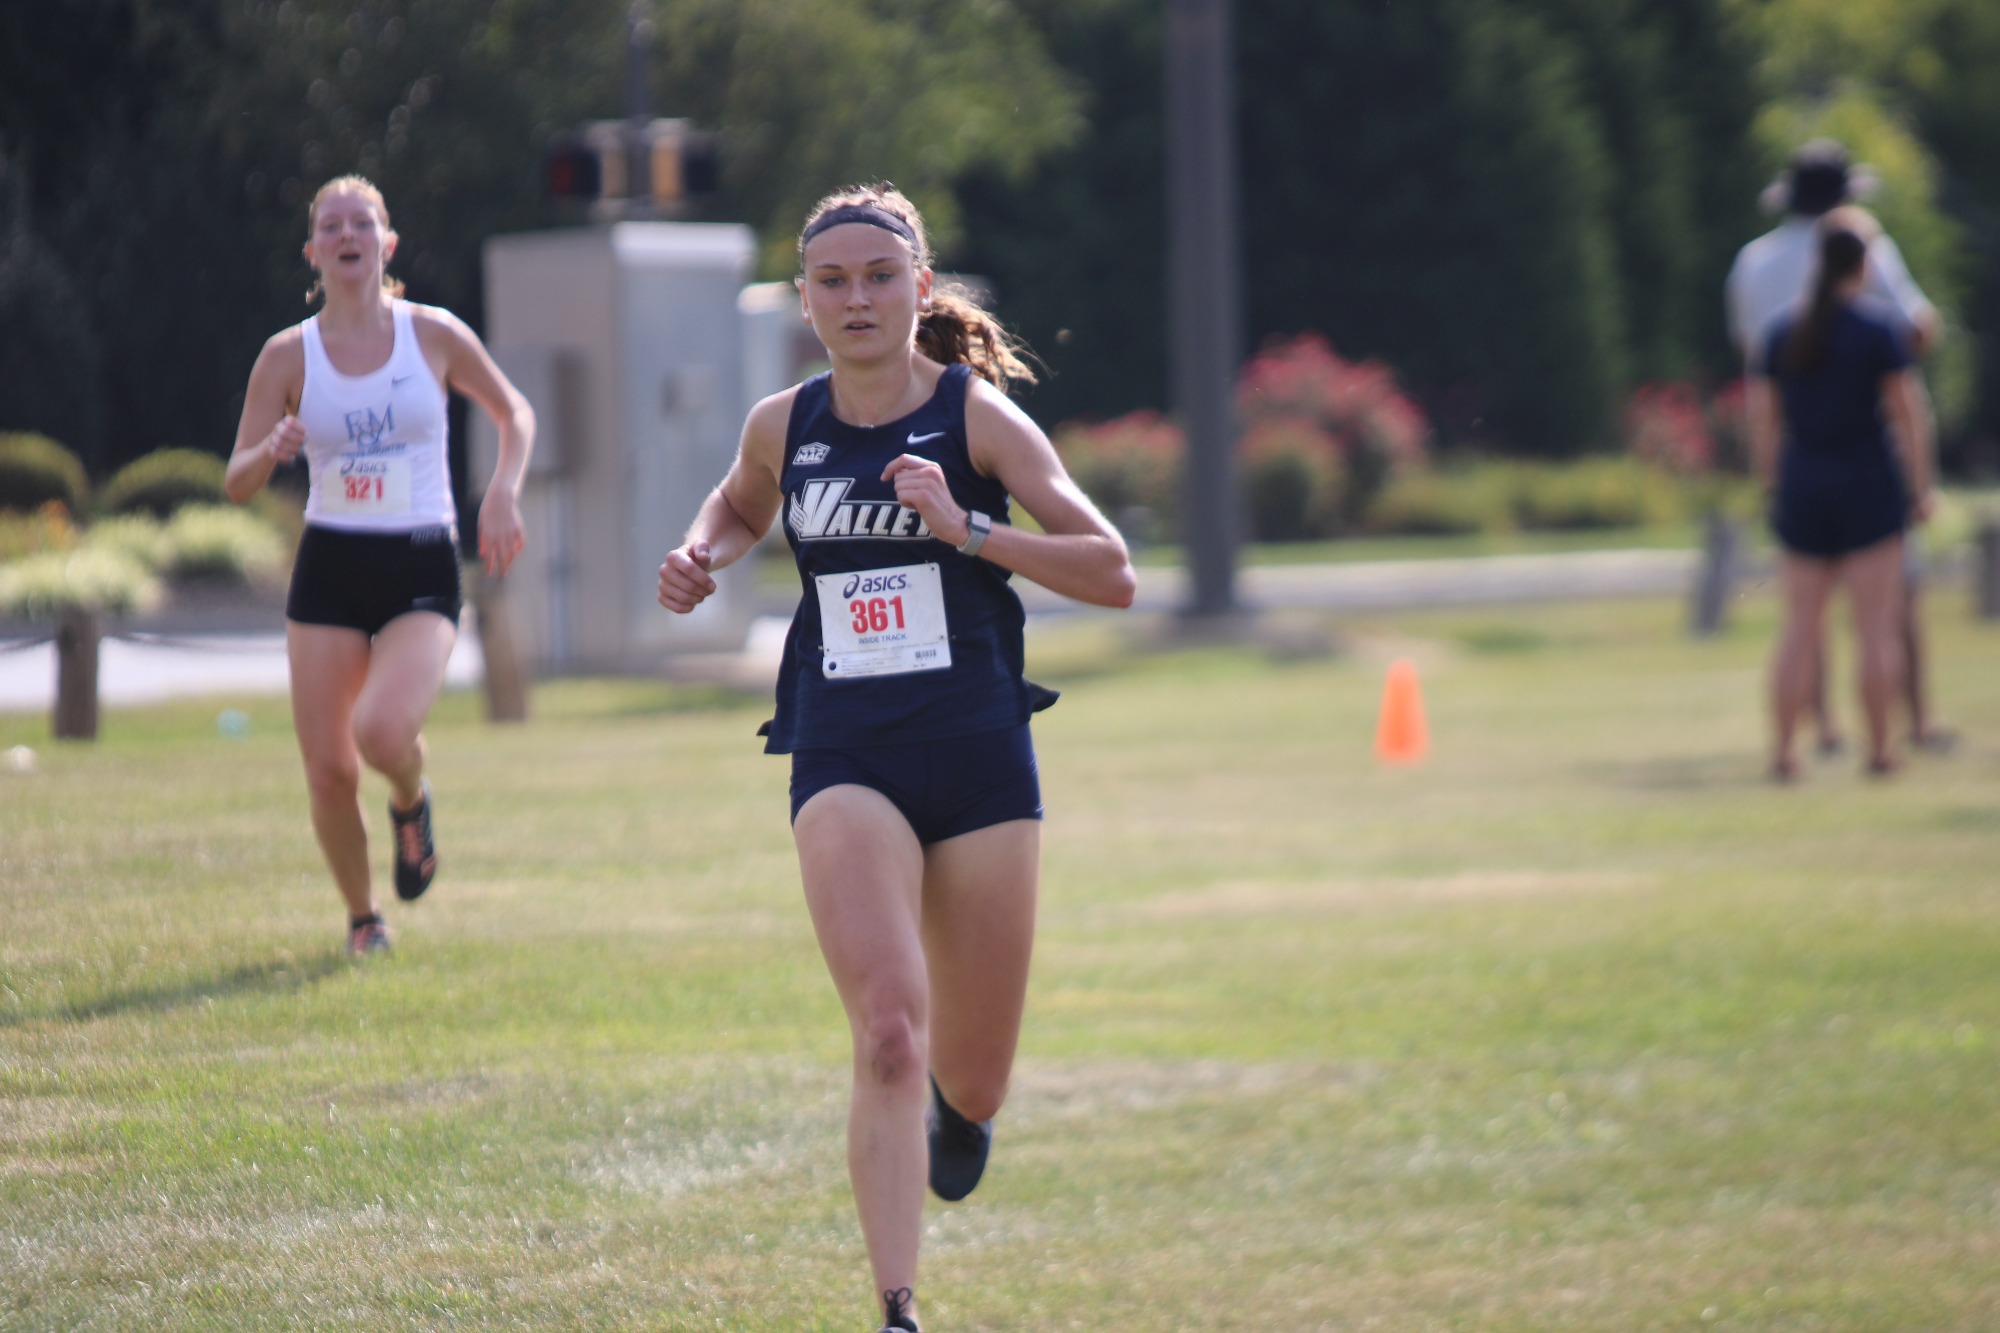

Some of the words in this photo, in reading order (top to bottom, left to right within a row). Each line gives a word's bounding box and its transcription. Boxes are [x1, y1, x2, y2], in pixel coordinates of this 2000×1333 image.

[797, 450, 825, 463] MAC
[345, 477, 384, 501] 321
[850, 595, 904, 633] 361
[858, 635, 880, 645] INSIDE
[881, 633, 907, 642] TRACK
